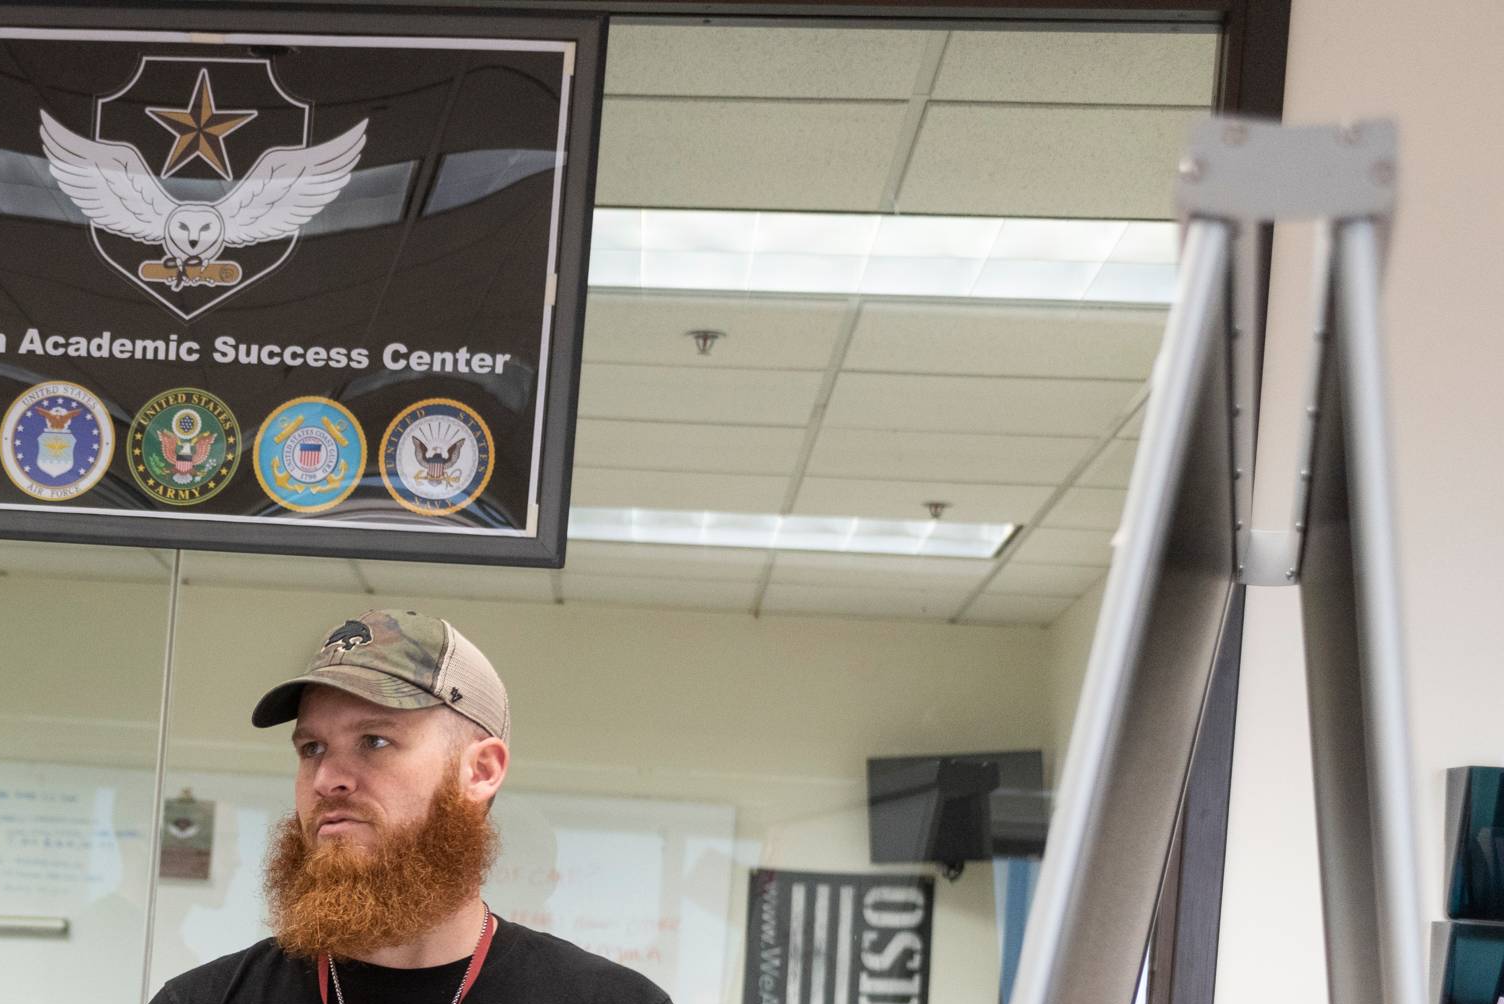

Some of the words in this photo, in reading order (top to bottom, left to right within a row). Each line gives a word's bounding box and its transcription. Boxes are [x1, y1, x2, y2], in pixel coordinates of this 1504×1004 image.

[18, 328, 201, 362] Academic
[212, 336, 370, 369] Success
[382, 343, 511, 374] Center
[21, 385, 59, 406] UNITED
[63, 386, 98, 410] STATES
[139, 393, 186, 425] UNITED
[191, 394, 234, 430] STATES
[386, 409, 425, 468] UNITED
[458, 412, 488, 472] STATES
[27, 483, 44, 496] AIR
[155, 485, 202, 500] ARMY
